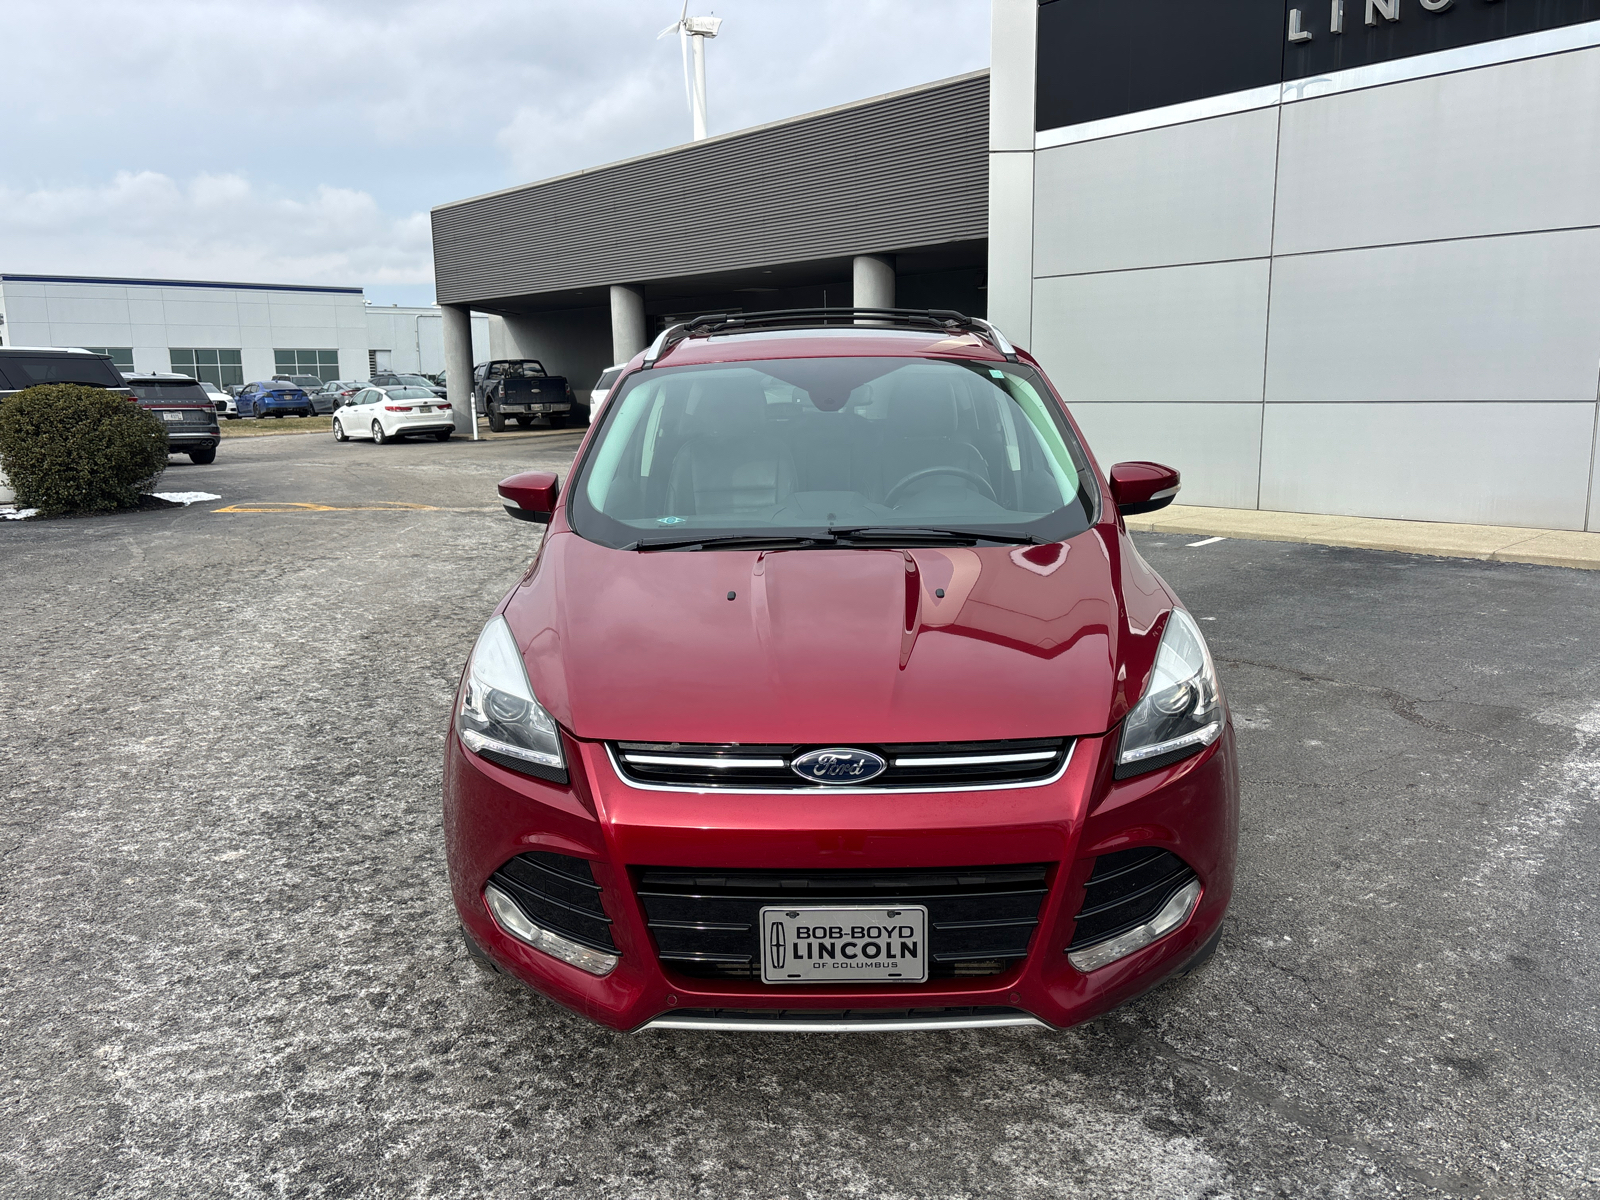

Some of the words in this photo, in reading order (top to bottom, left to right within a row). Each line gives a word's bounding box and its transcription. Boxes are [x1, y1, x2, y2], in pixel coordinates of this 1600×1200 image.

[813, 753, 865, 776] Ford
[796, 925, 914, 939] BOB-BOYD
[793, 941, 918, 960] LINCOLN
[832, 961, 899, 969] COLUMBUS
